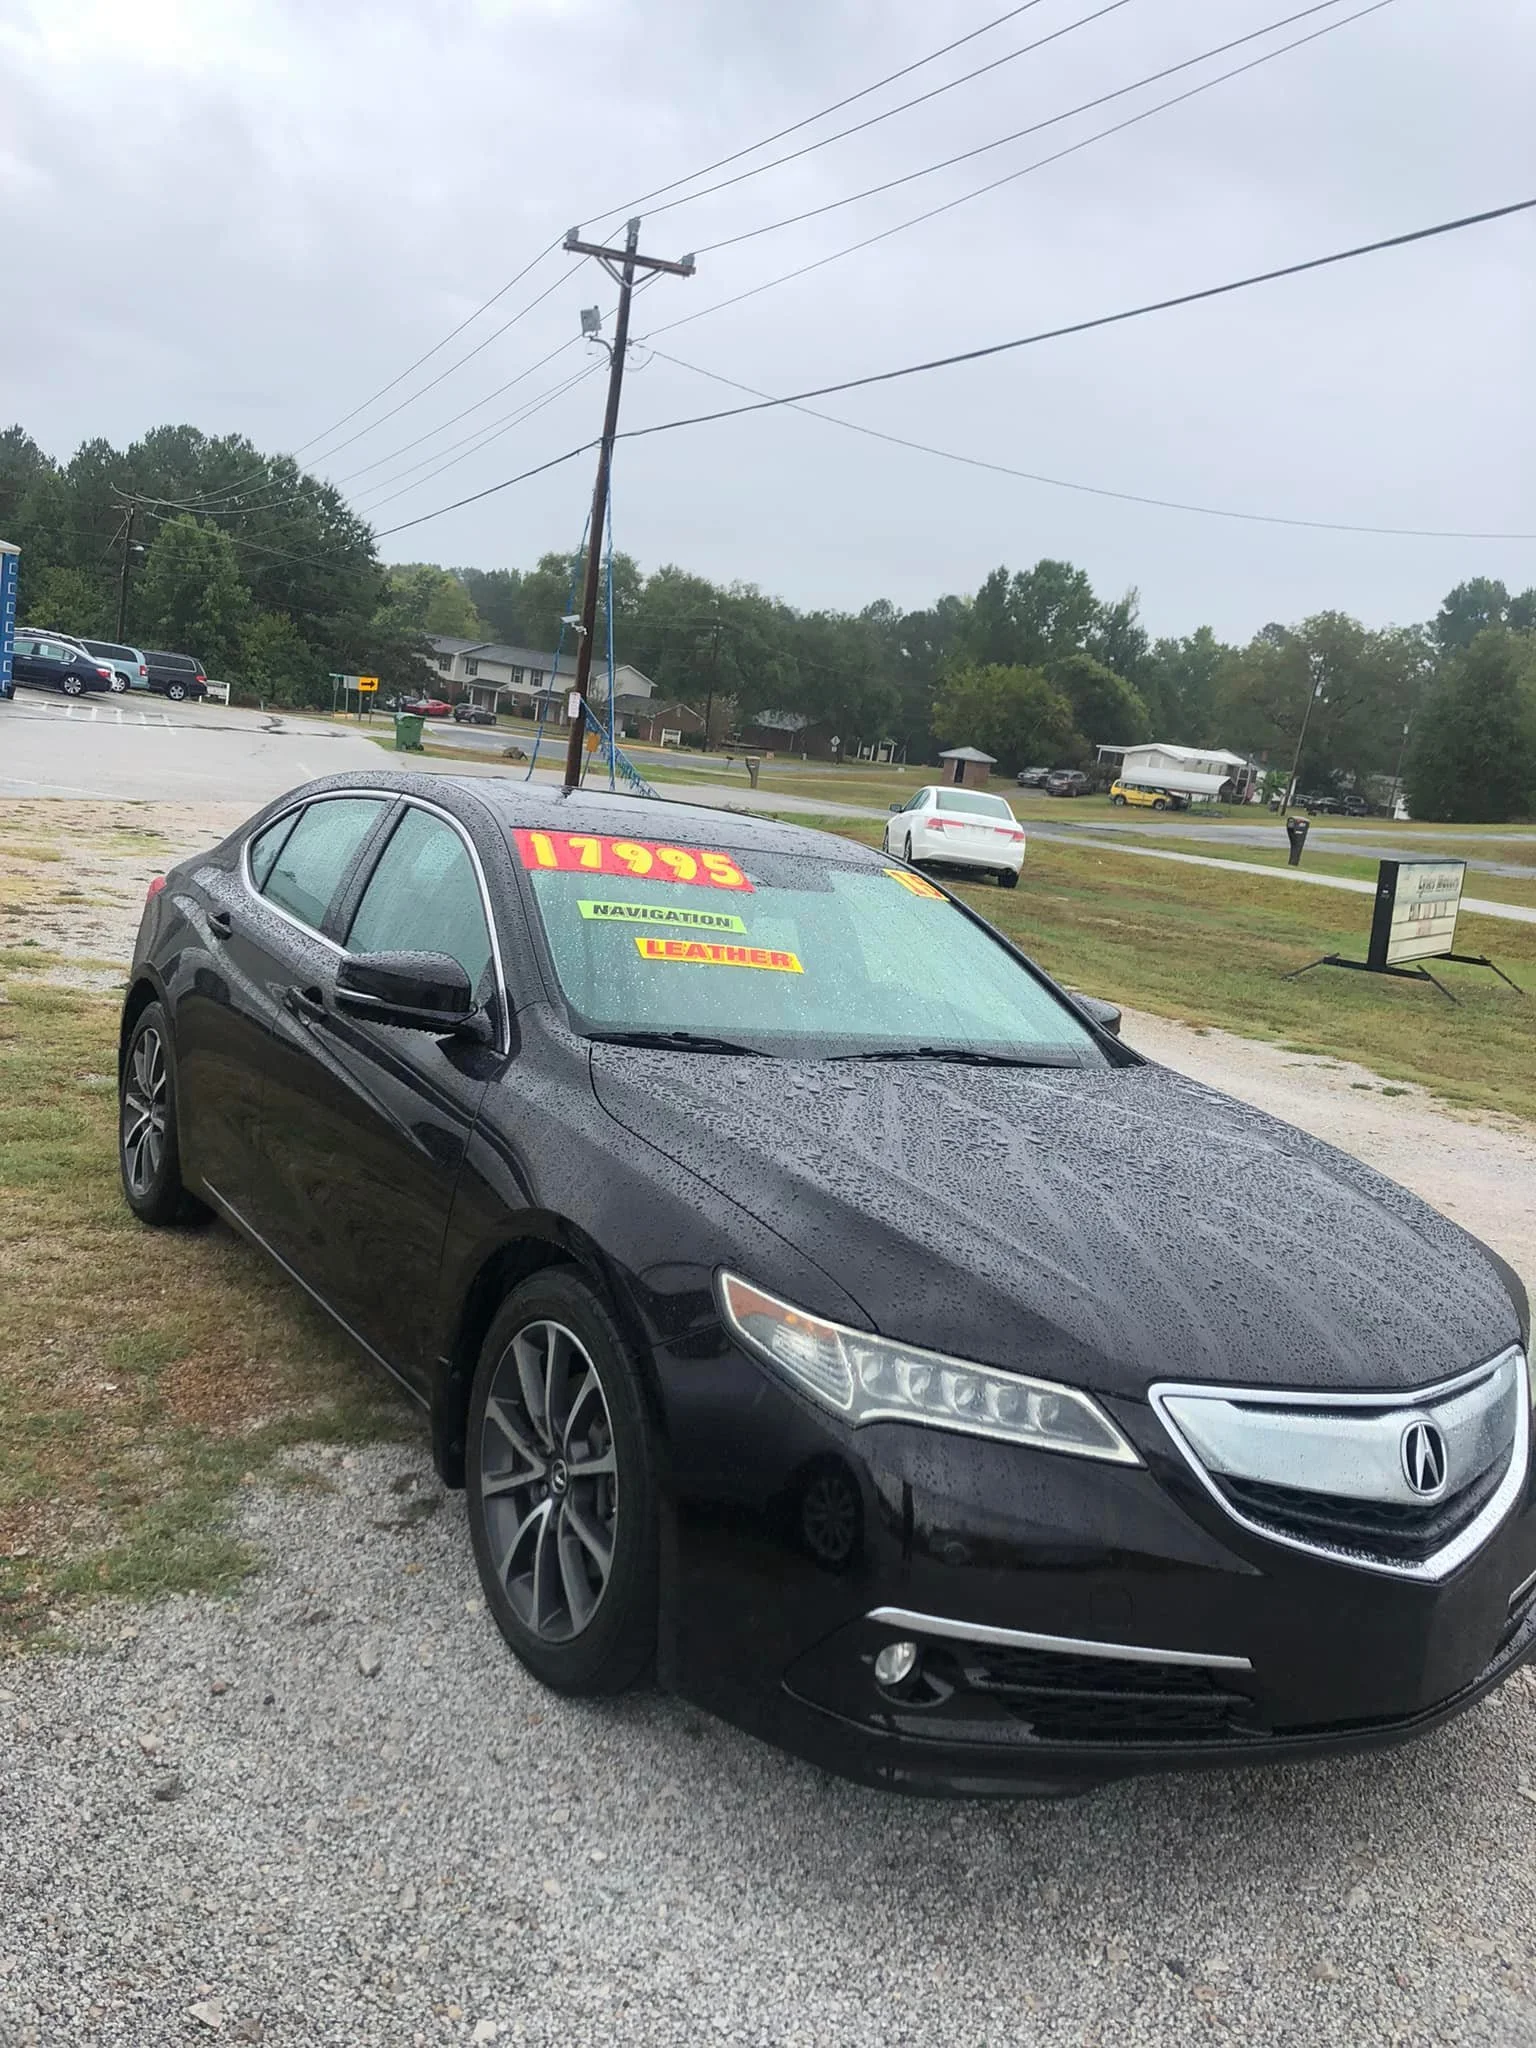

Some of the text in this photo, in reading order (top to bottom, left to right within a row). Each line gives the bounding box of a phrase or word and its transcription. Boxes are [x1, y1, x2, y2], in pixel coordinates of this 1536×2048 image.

[530, 832, 744, 886] 17995
[592, 904, 734, 929] NAVIGATION
[646, 940, 792, 968] LEATHER
